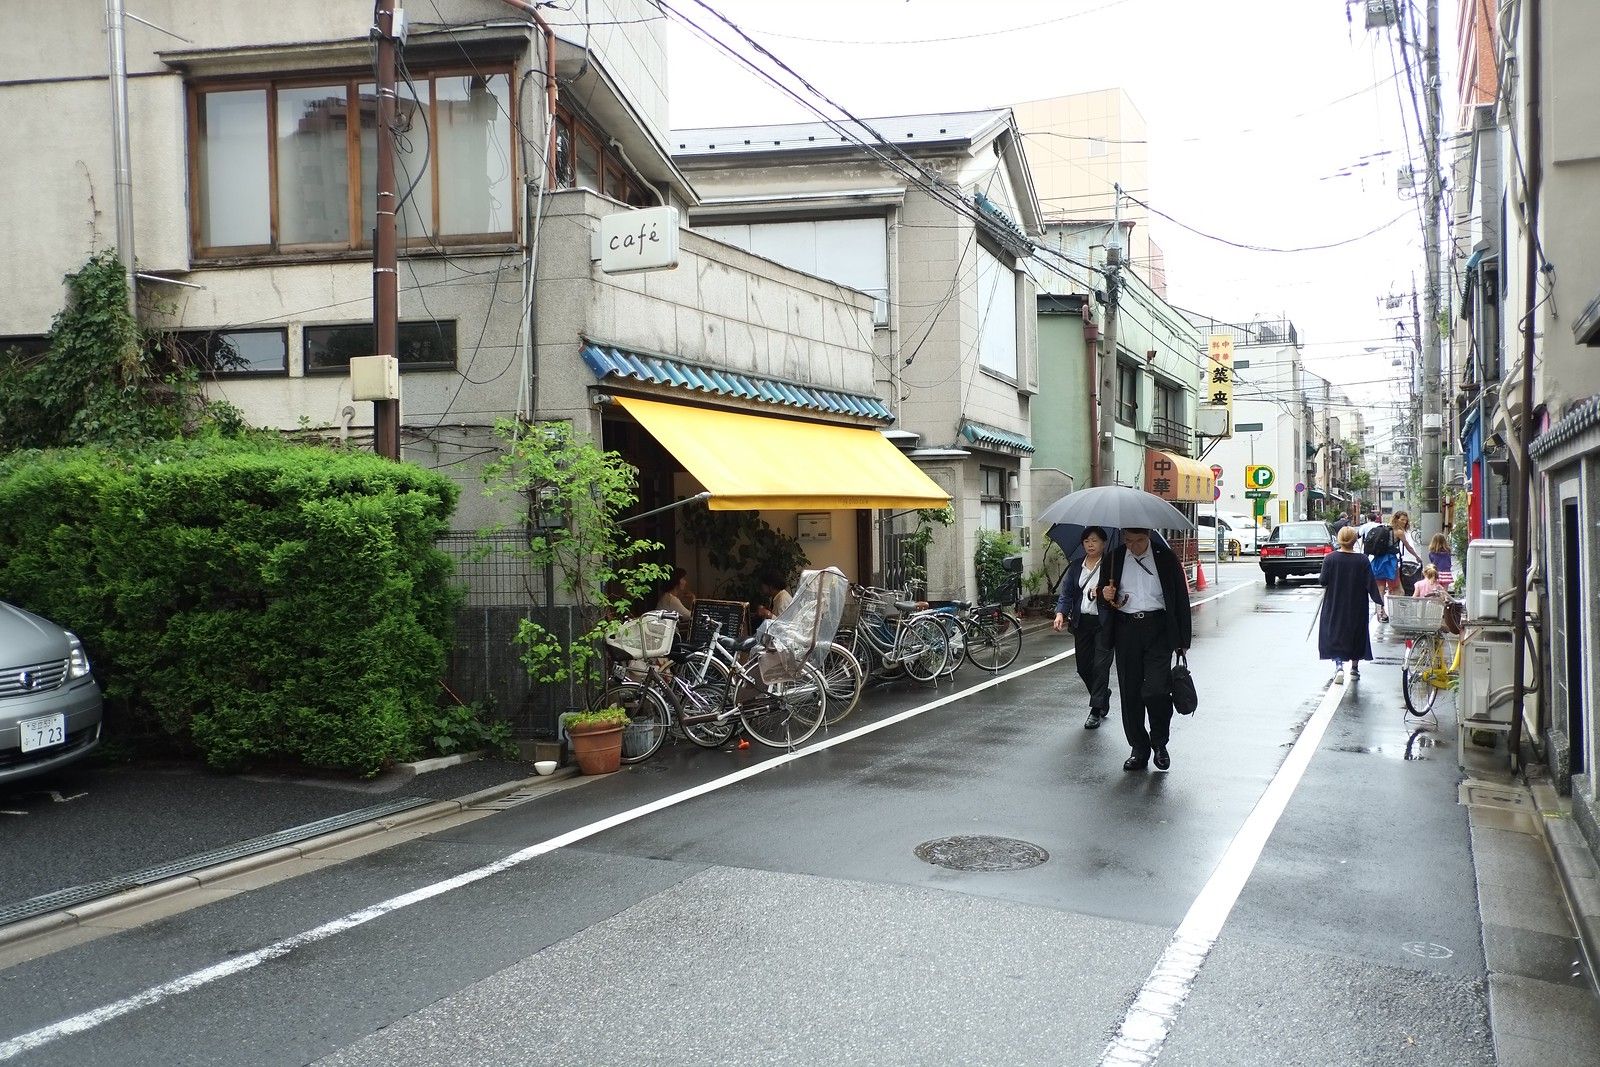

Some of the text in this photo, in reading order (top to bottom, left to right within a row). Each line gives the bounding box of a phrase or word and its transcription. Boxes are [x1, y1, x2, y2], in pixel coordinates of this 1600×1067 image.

[609, 222, 660, 256] café
[1153, 458, 1172, 496] 中華
[1258, 469, 1271, 485] P
